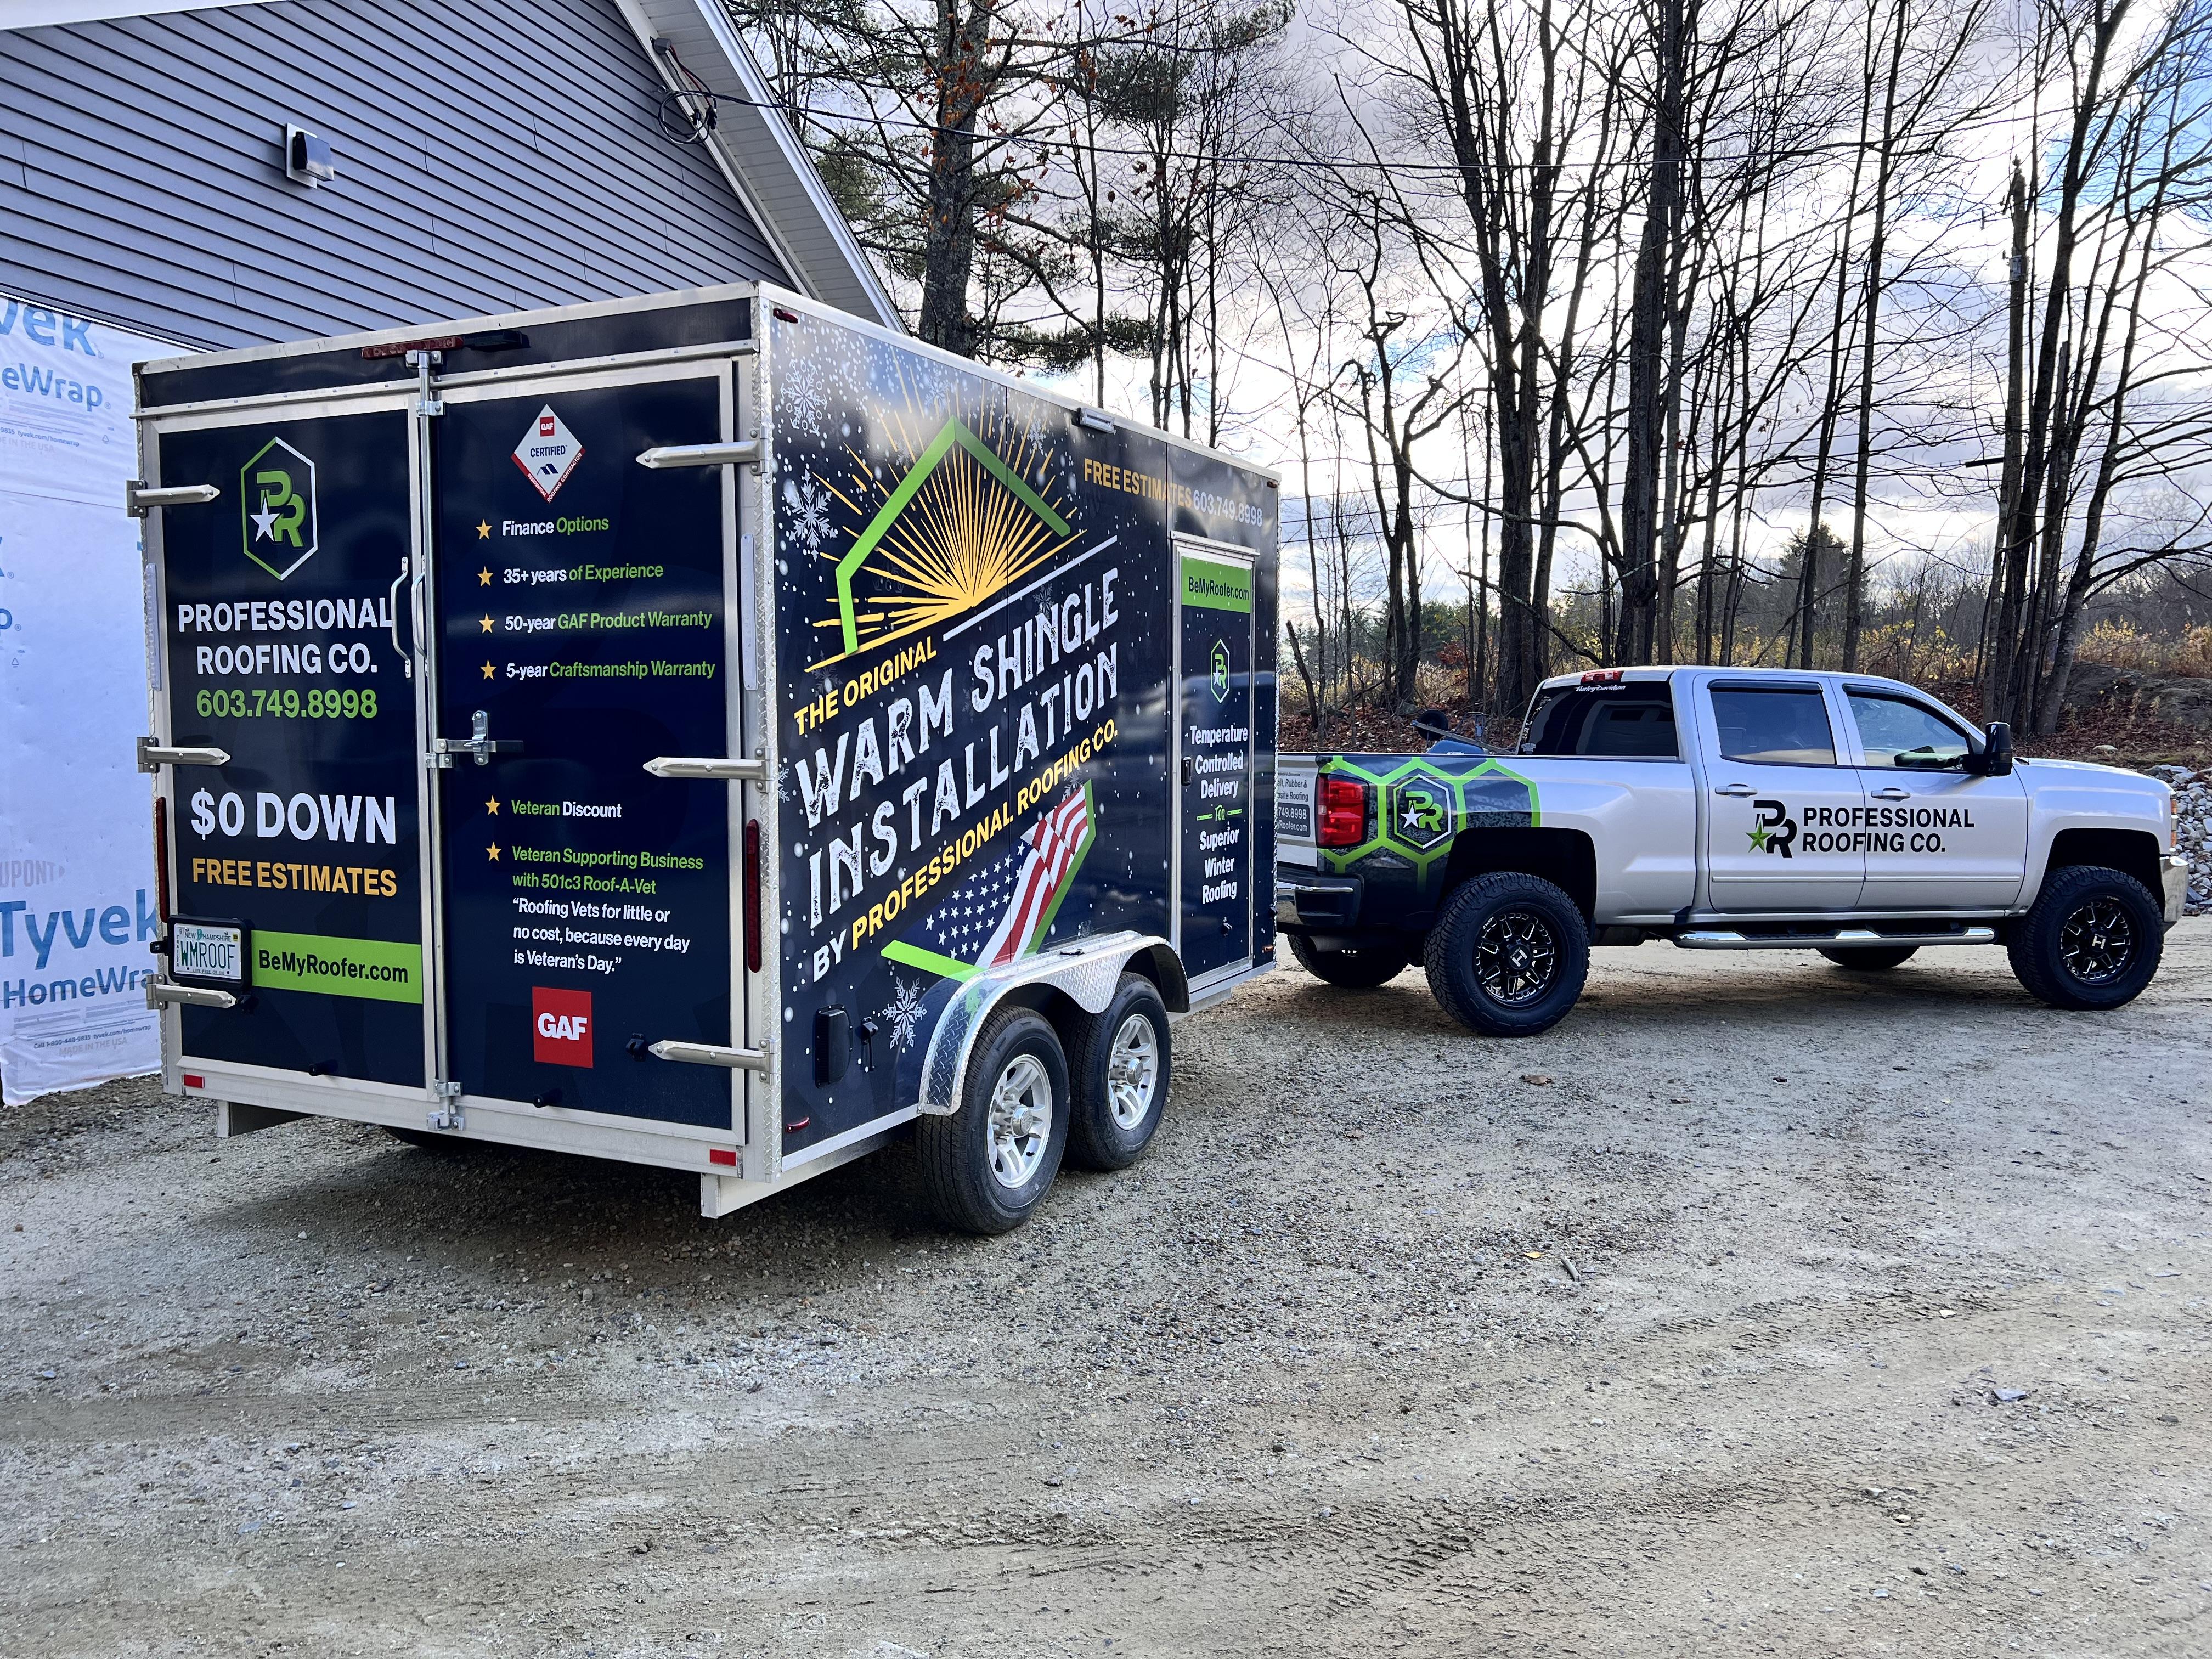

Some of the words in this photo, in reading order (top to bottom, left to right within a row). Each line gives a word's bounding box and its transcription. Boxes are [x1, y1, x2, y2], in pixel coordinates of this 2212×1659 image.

[2, 363, 103, 411] eWrap
[530, 445, 566, 458] CERTIFIED
[546, 481, 562, 503] ROOFING
[561, 452, 582, 483] CONTRACTOR
[1084, 458, 1120, 490] FREE
[1123, 469, 1192, 509] ESTIMATES
[1193, 489, 1263, 527] 603.749.8998
[503, 520, 554, 536] Finance
[556, 516, 609, 535] Options
[503, 568, 529, 583] 35+
[531, 568, 567, 585] years
[569, 566, 583, 580] of
[585, 563, 663, 582] Experience
[1188, 576, 1249, 600] BeMyRoofer.com
[178, 598, 393, 633] PROFESSIONAL
[505, 616, 556, 633] 50-year
[557, 613, 588, 630] GAF
[590, 611, 645, 629] Product
[648, 611, 712, 629] Warranty
[196, 644, 322, 674] ROOFING
[329, 642, 378, 674] CO.
[506, 663, 548, 680] 5-year
[550, 661, 648, 678] Craftsmanship
[651, 660, 715, 679] Warranty
[793, 693, 839, 736] THE
[843, 635, 937, 708] ORIGINAL
[794, 668, 954, 828] WARM
[970, 567, 1119, 713] SHINGLE
[196, 689, 377, 719] 603.749.8998
[1190, 725, 1248, 747] Temperature
[1195, 751, 1244, 774] Controlled
[808, 641, 1118, 930] INSTALLATION
[1200, 780, 1239, 800] Delivery
[1285, 778, 1303, 787] Rubber
[1304, 780, 1307, 788] &
[511, 799, 560, 816] Veteran
[562, 801, 622, 818] Discount
[1290, 791, 1308, 802] Roofing
[191, 787, 245, 840] $0
[256, 792, 396, 844] DOWN
[1215, 804, 1226, 822] FOR
[1803, 807, 1975, 828] PROFESSIONAL
[813, 929, 848, 983] BY
[852, 809, 1012, 951] PROFESSIONAL
[1017, 742, 1090, 811] ROOFING
[1093, 719, 1119, 752] CO.
[1199, 828, 1239, 850] Superior
[1802, 832, 1904, 853] ROOFING
[1910, 832, 1946, 853] CO.
[512, 845, 561, 862] Veteran
[563, 848, 637, 869] Supporting
[640, 852, 704, 870] Business
[1204, 856, 1234, 878] Winter
[193, 857, 252, 887] FREE
[257, 862, 397, 897] ESTIMATES
[512, 873, 539, 888] with
[541, 874, 581, 889] 501c3
[584, 876, 656, 894] Roof-A-Vet
[1202, 882, 1237, 905] Roofing
[513, 898, 568, 918] “Roofing
[571, 901, 600, 918] Vets
[602, 903, 621, 919] for
[623, 904, 653, 921] little
[655, 909, 670, 922] or
[202, 934, 232, 942] HAMPSHIRE
[513, 926, 530, 939] no
[532, 927, 563, 944] cost,
[565, 927, 622, 945] because
[624, 934, 663, 952] every
[664, 934, 690, 953] day
[180, 940, 235, 970] WMROOF
[259, 950, 408, 983] BeMyRoofer.com
[514, 949, 524, 964] is
[527, 950, 585, 969] Veteran’s
[587, 955, 622, 974] Day.”
[537, 1012, 588, 1041] GAF
